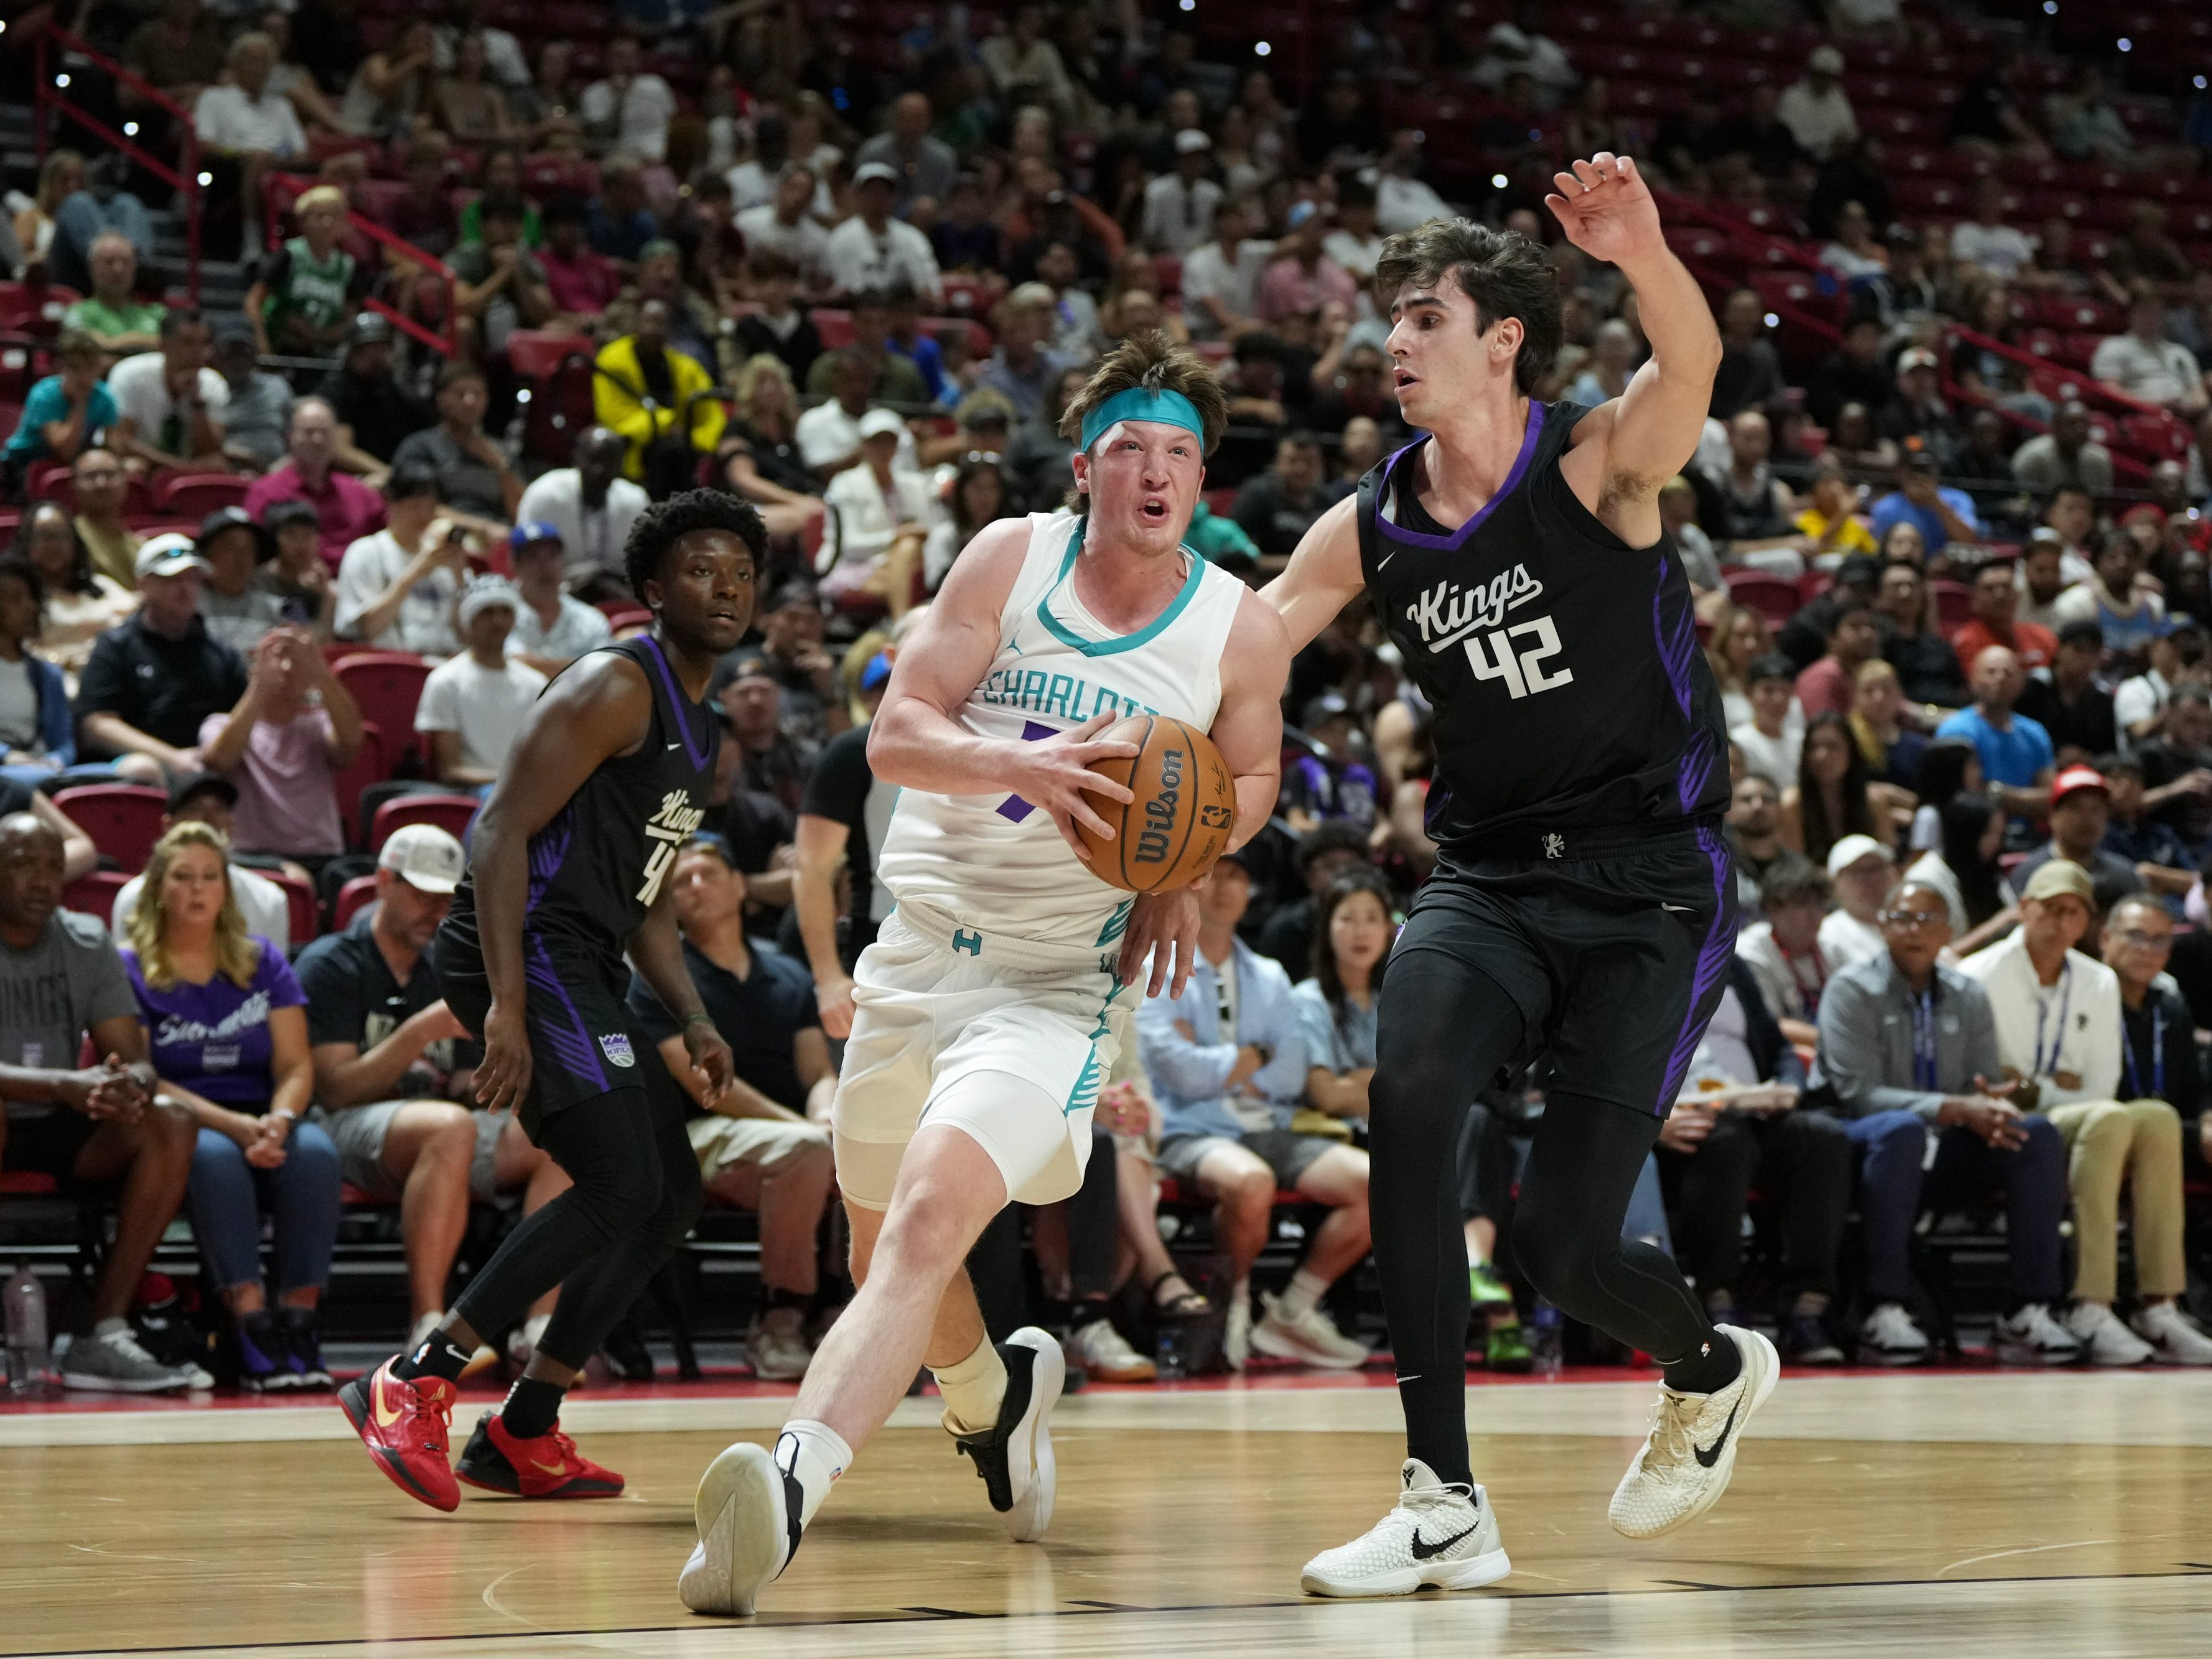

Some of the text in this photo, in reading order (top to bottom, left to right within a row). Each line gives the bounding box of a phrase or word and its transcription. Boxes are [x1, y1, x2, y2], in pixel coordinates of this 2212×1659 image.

[1406, 562, 1543, 654] Kings
[1463, 615, 1574, 700] 42
[1134, 748, 1184, 864] Wilson
